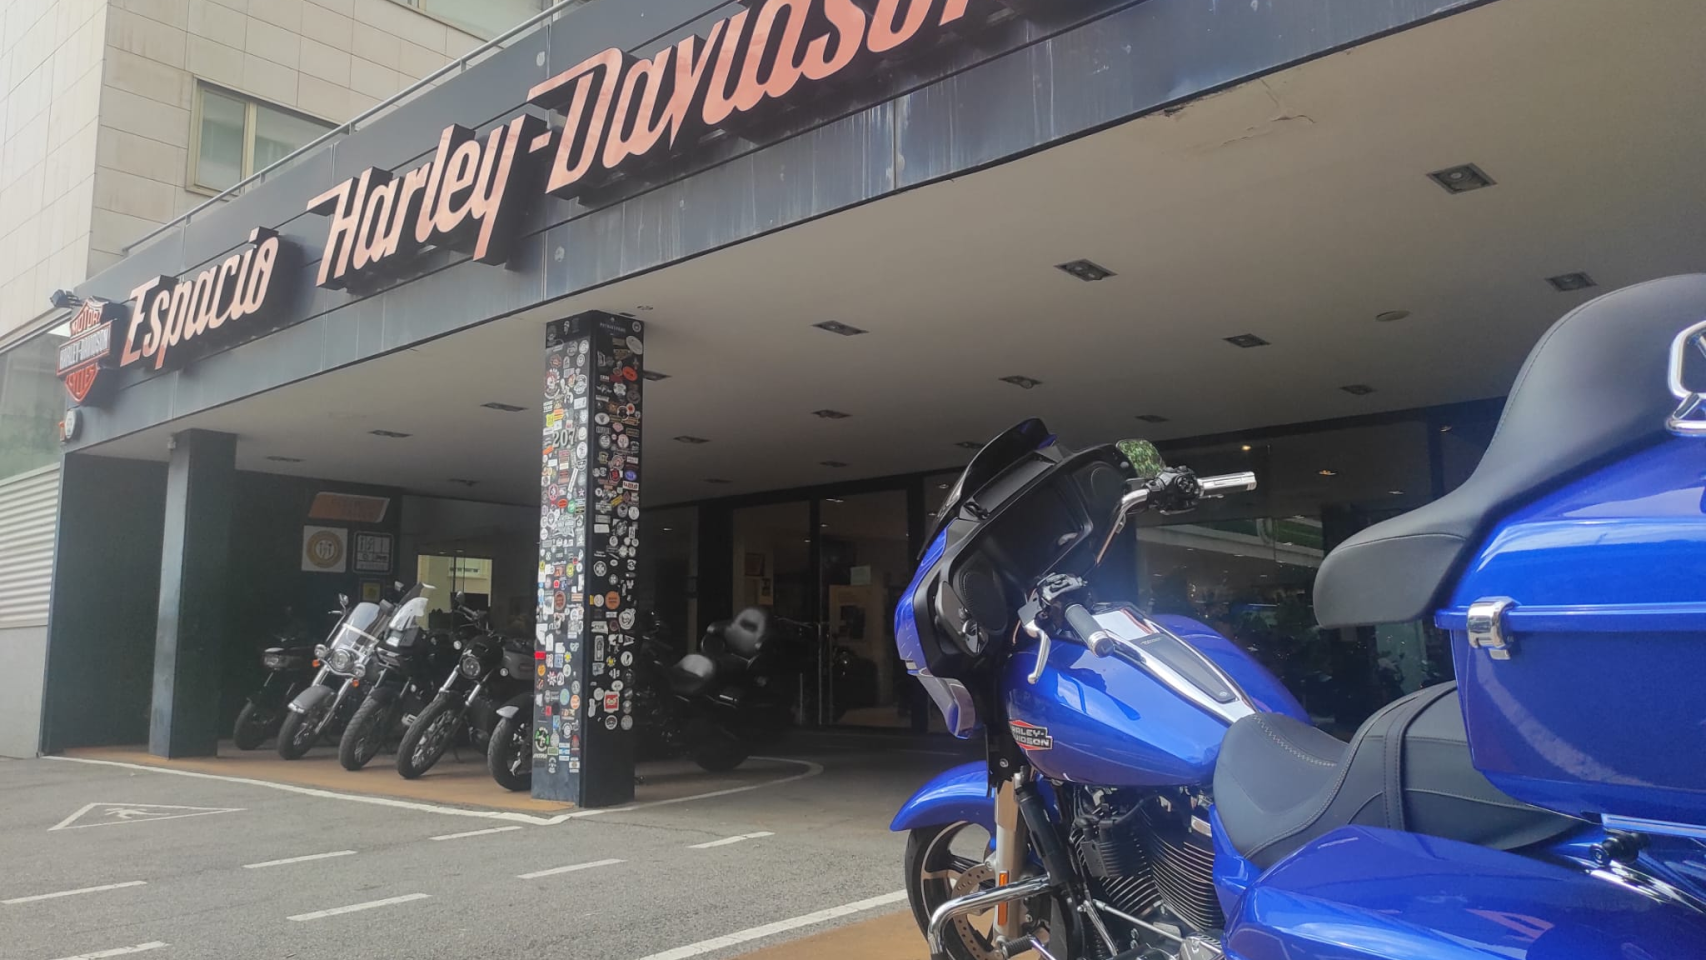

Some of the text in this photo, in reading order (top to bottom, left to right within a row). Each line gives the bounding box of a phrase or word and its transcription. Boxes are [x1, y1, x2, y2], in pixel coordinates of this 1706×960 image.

[120, 0, 968, 369] Espacio Harley-Davids
[1011, 726, 1044, 737] ARLEY-
